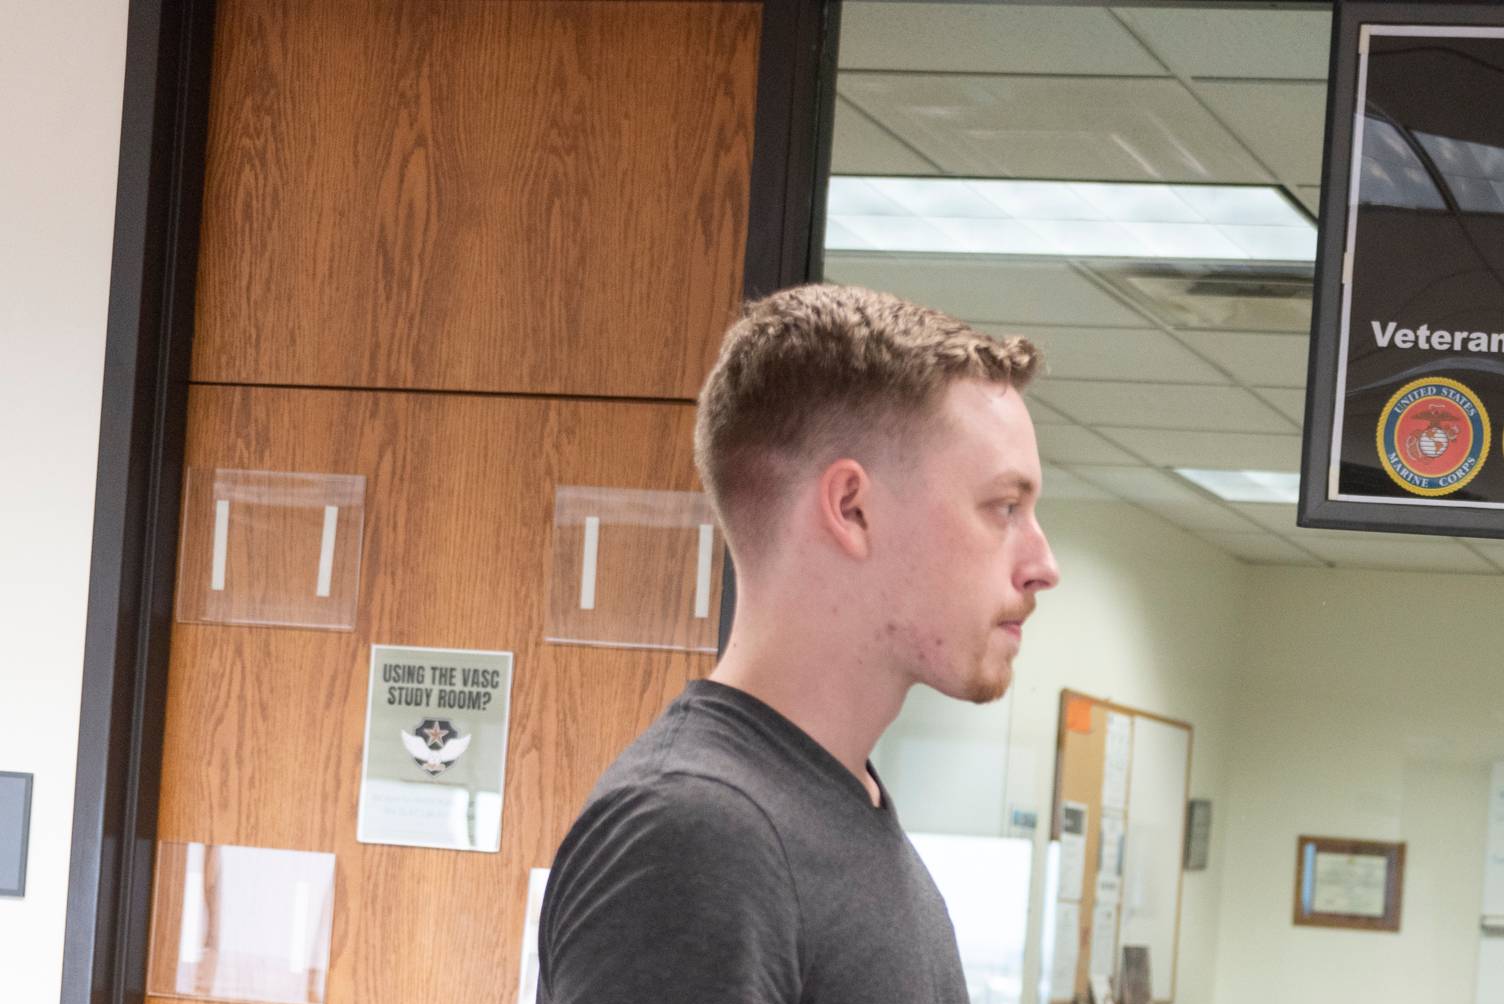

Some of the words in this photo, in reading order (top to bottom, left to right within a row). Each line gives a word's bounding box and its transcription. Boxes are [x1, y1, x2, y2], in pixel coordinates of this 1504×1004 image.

[1394, 386, 1437, 414] UNITED
[1440, 387, 1477, 417] STATES
[1388, 452, 1429, 487] MARINE
[1438, 456, 1476, 487] CORPS
[382, 663, 425, 685] USING
[431, 666, 456, 686] THE
[462, 668, 500, 690] VASC
[387, 686, 433, 707] STUDY
[438, 690, 492, 711] ROOM?
